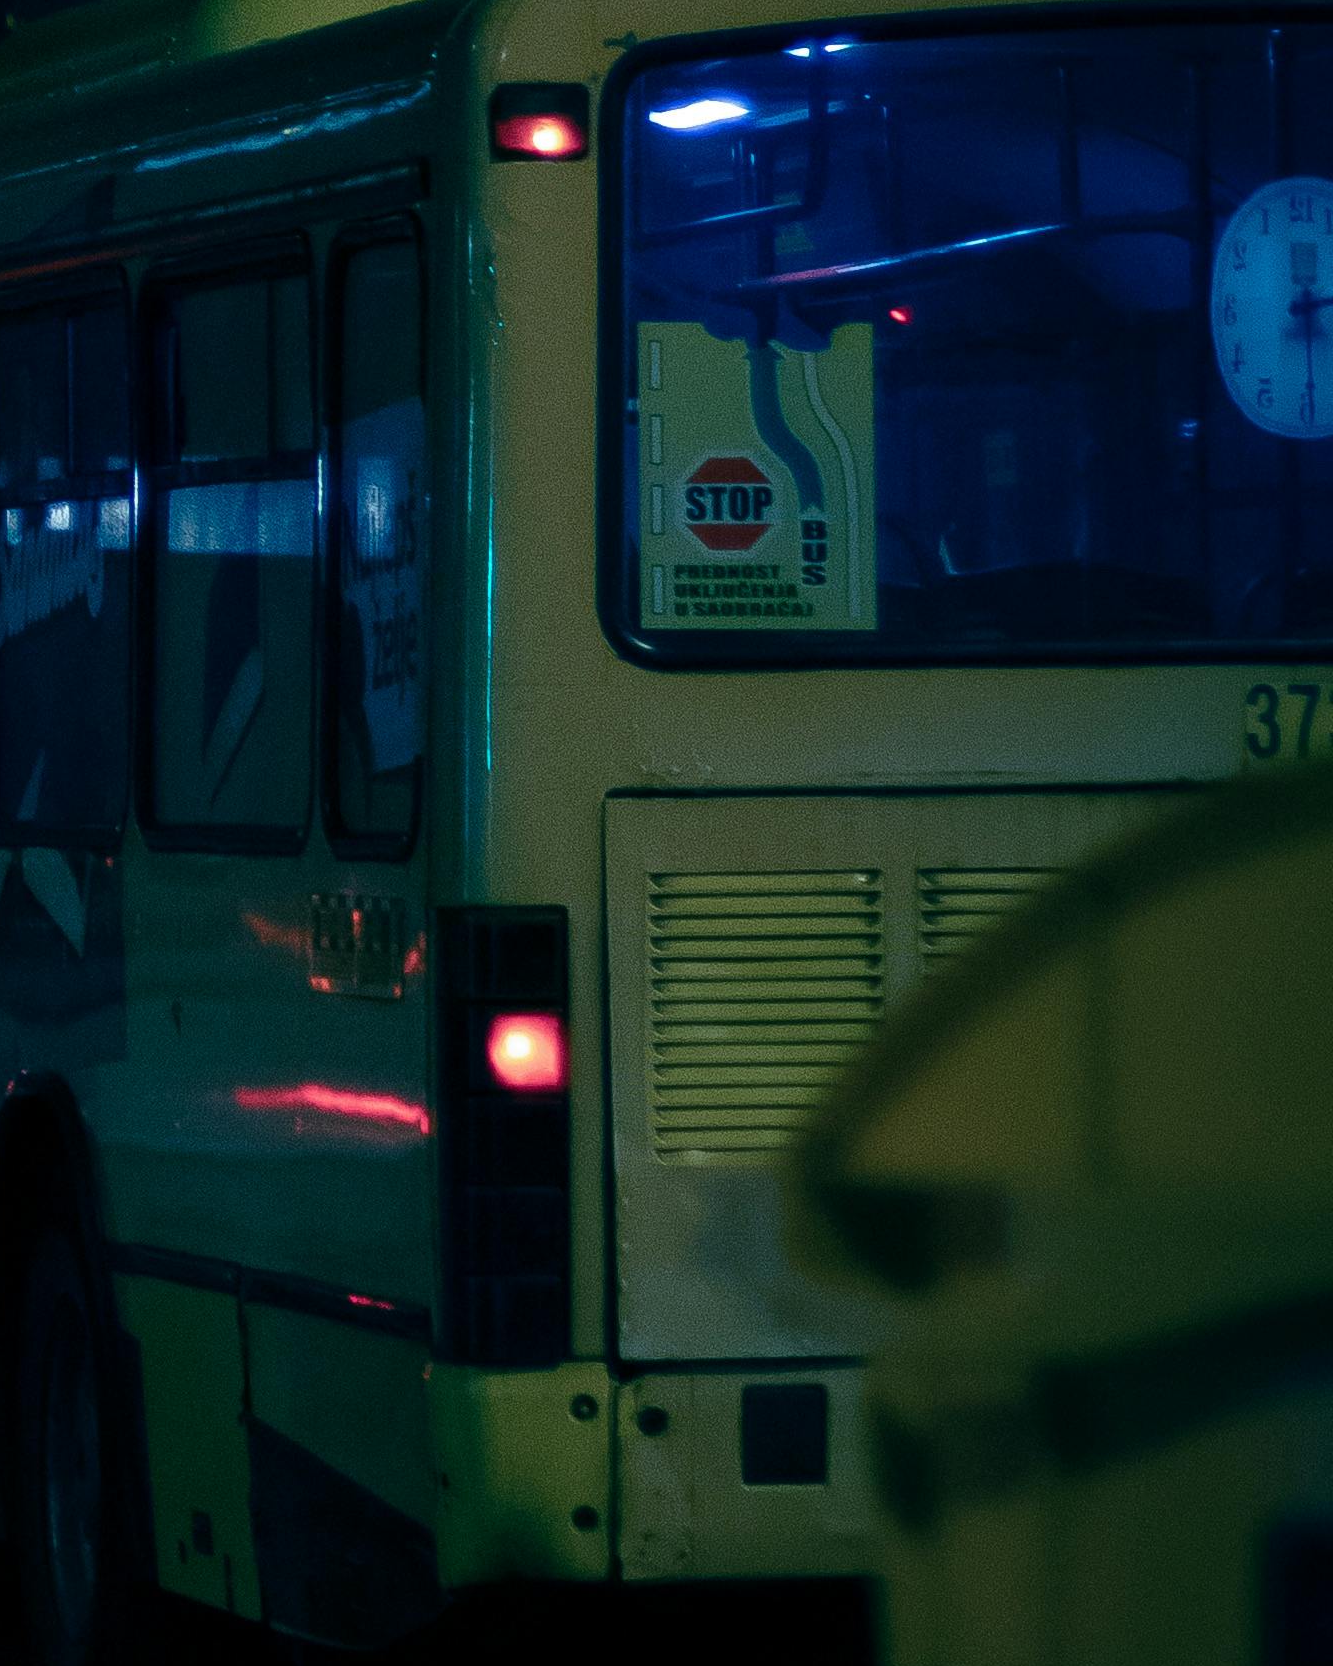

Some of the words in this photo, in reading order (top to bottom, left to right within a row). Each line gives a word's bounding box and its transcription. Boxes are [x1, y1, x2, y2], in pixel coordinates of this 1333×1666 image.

[684, 485, 774, 522] STOP
[801, 519, 828, 586] BUS
[673, 564, 780, 580] PREDNOST
[673, 602, 689, 617] U
[1245, 683, 1333, 761] 37
